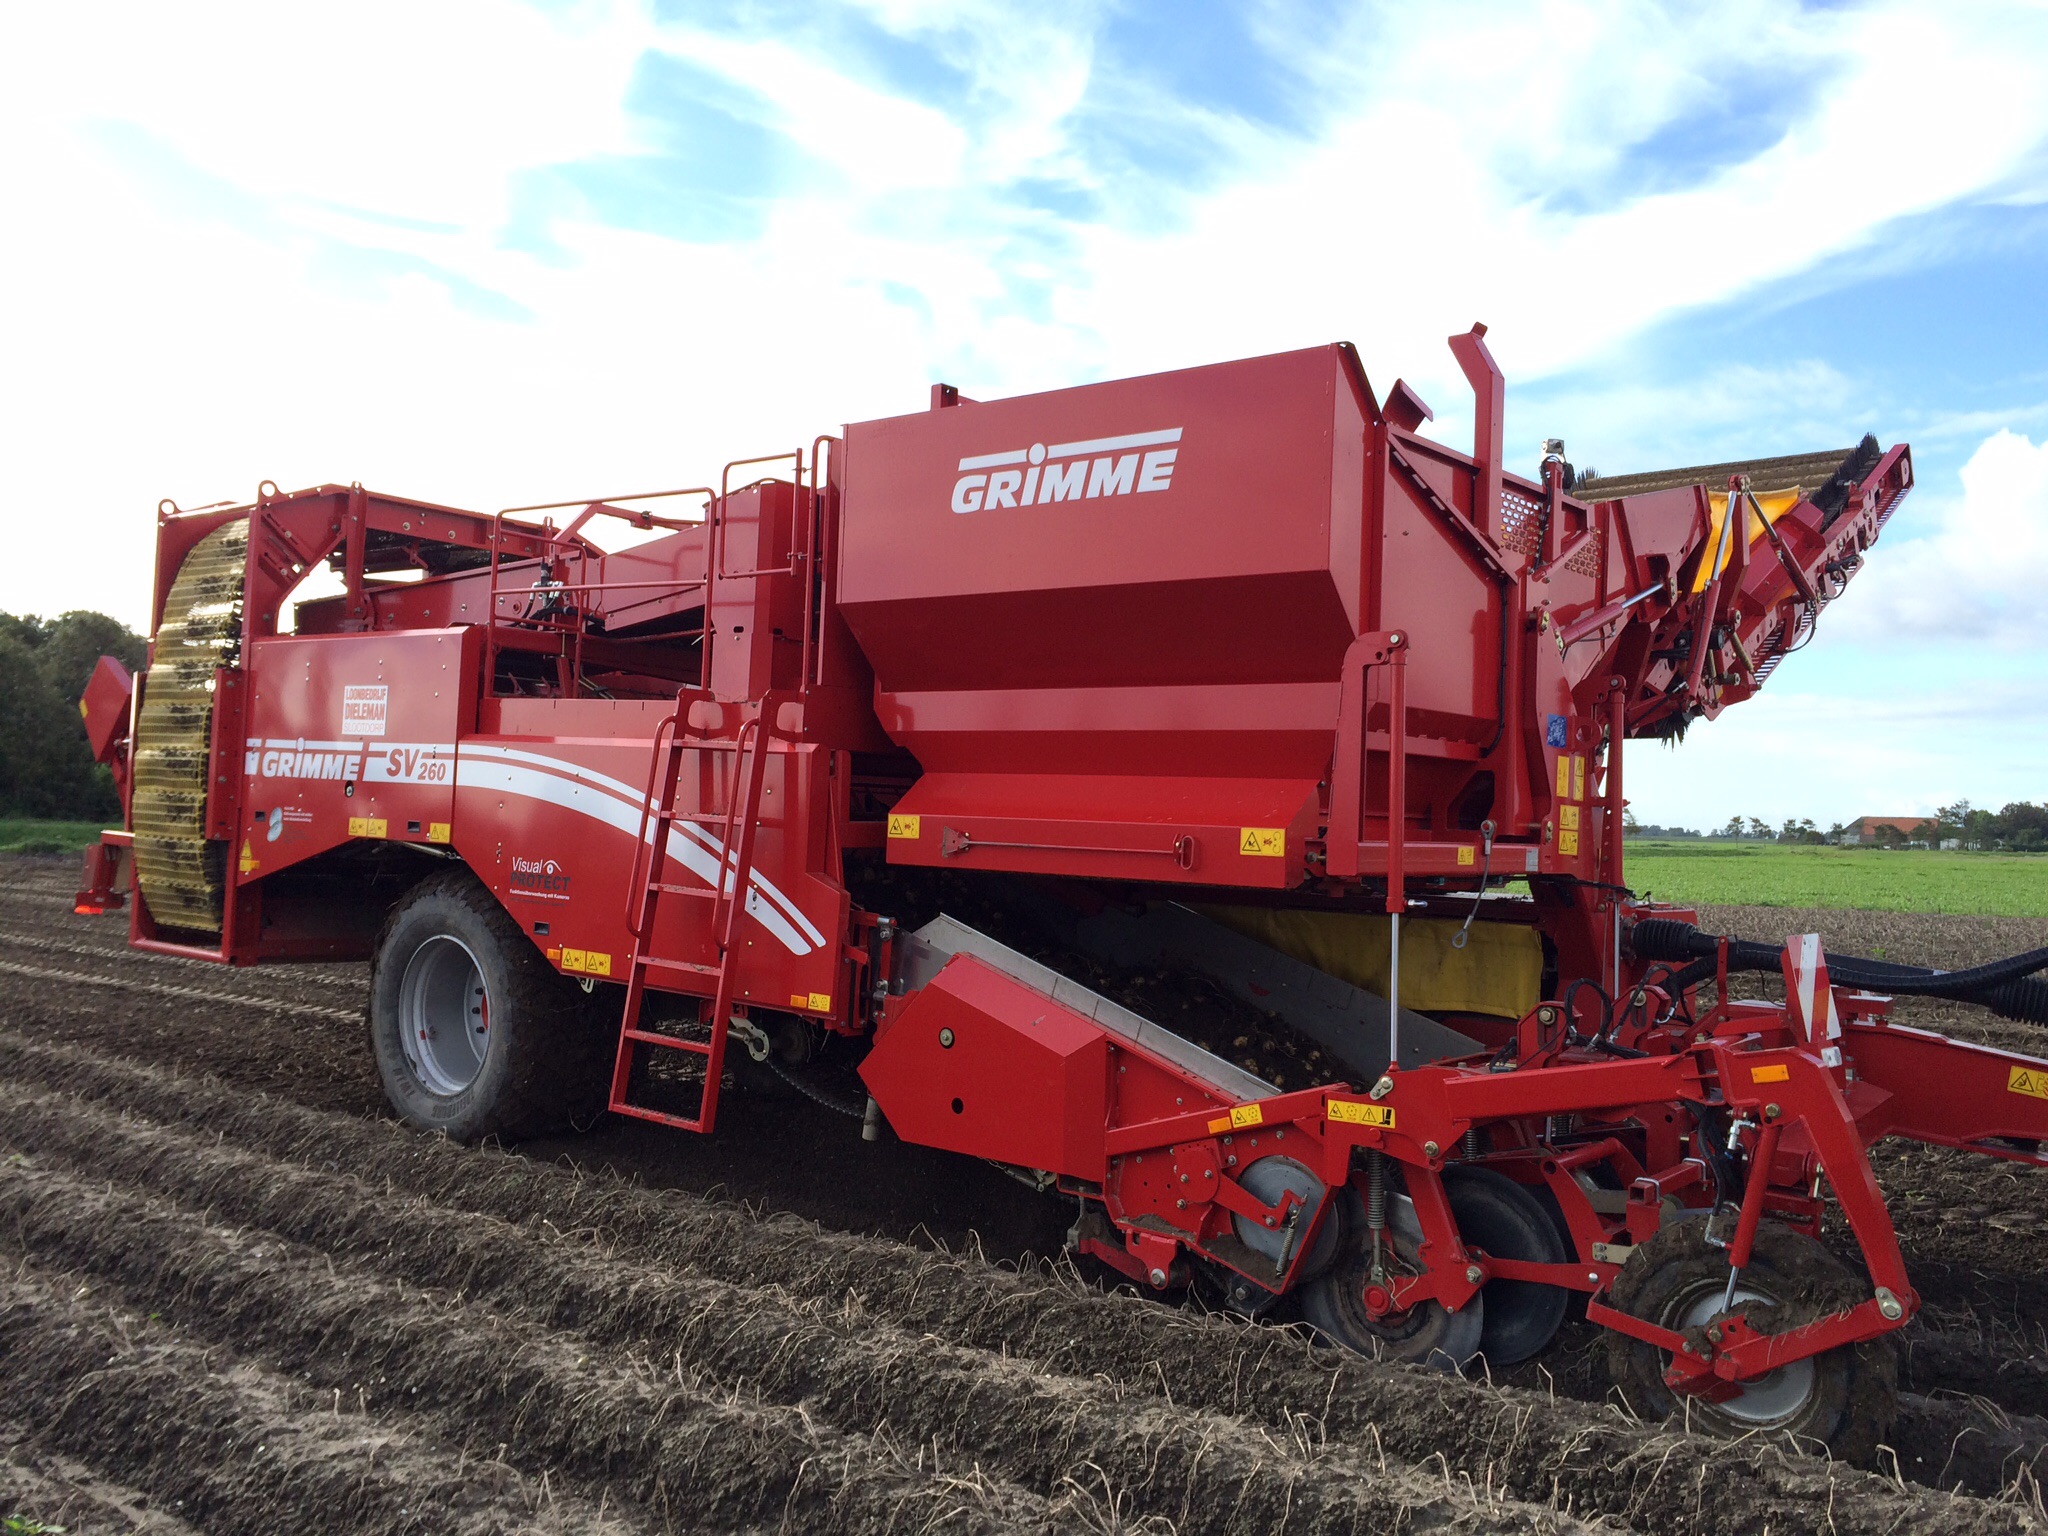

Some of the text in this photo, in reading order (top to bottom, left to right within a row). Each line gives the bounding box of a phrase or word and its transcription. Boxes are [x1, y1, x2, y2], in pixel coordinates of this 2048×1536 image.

[951, 438, 1180, 514] GRIMME
[344, 703, 385, 720] DIELEMAN
[262, 737, 362, 780] GRIMME
[386, 749, 446, 781] SV 260
[512, 856, 543, 874] Visual
[510, 871, 571, 891] PROTECT
